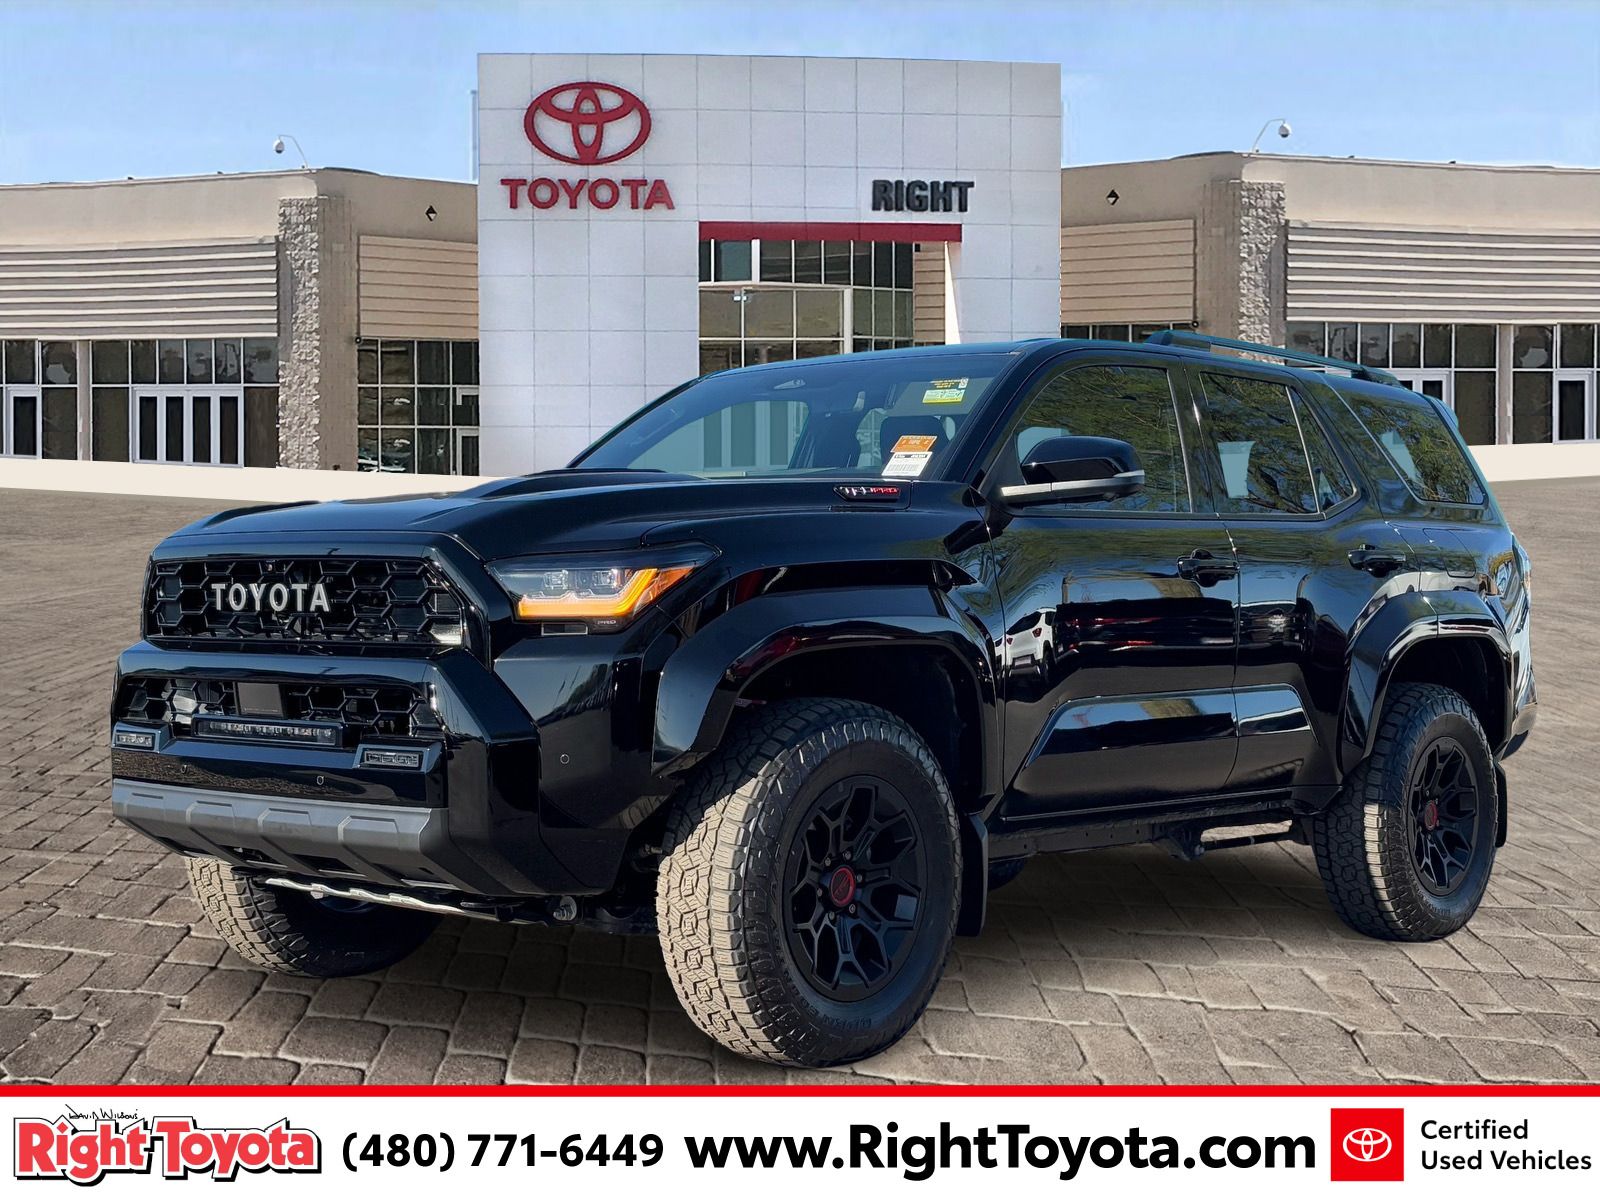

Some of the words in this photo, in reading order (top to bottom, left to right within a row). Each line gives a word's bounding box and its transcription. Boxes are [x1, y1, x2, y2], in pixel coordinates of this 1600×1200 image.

[501, 179, 675, 210] TOYOTA
[871, 179, 975, 213] RIGHT
[211, 583, 330, 612] TOYOTA
